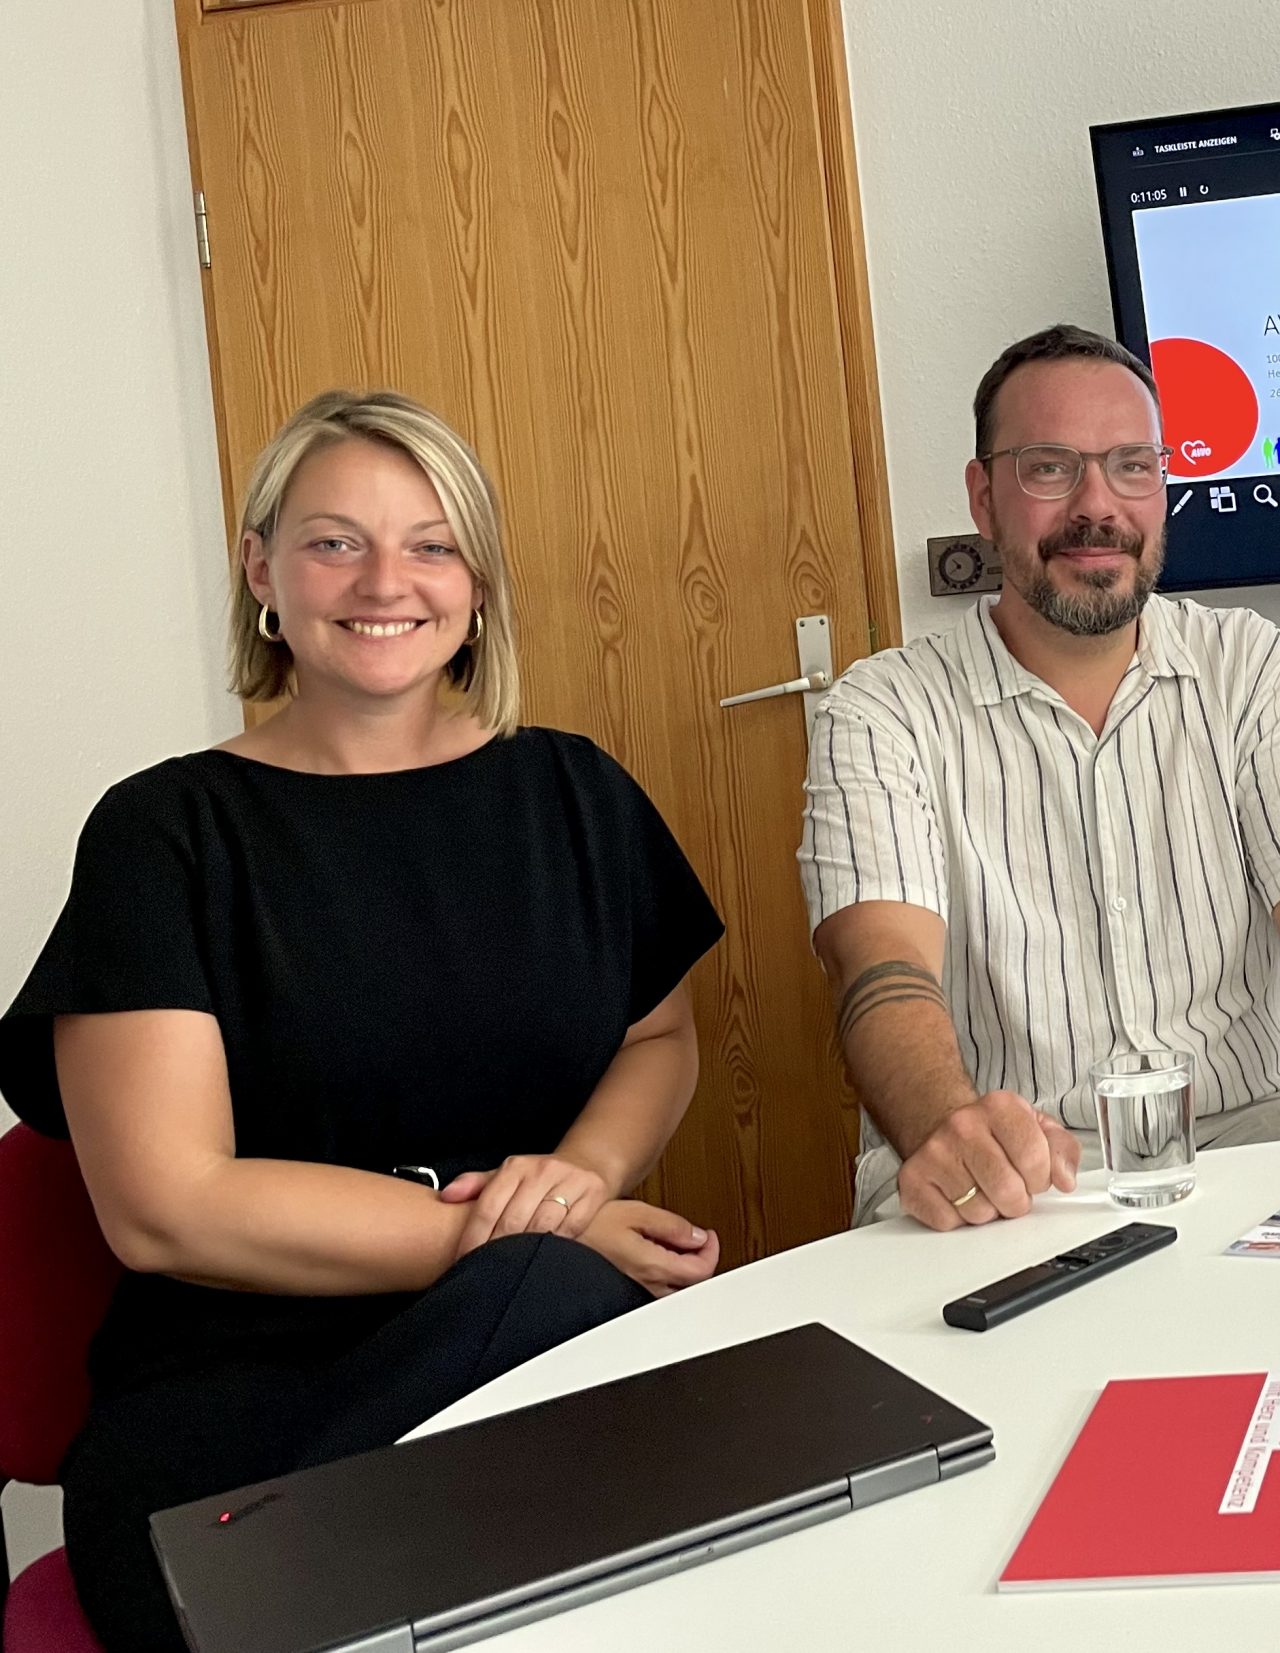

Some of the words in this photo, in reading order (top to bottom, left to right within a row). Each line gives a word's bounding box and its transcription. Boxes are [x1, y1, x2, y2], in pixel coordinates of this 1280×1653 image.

[1154, 141, 1197, 153] TASKLEISTE
[1198, 136, 1237, 148] ANZEIGEN
[1130, 189, 1168, 203] 0:11:05
